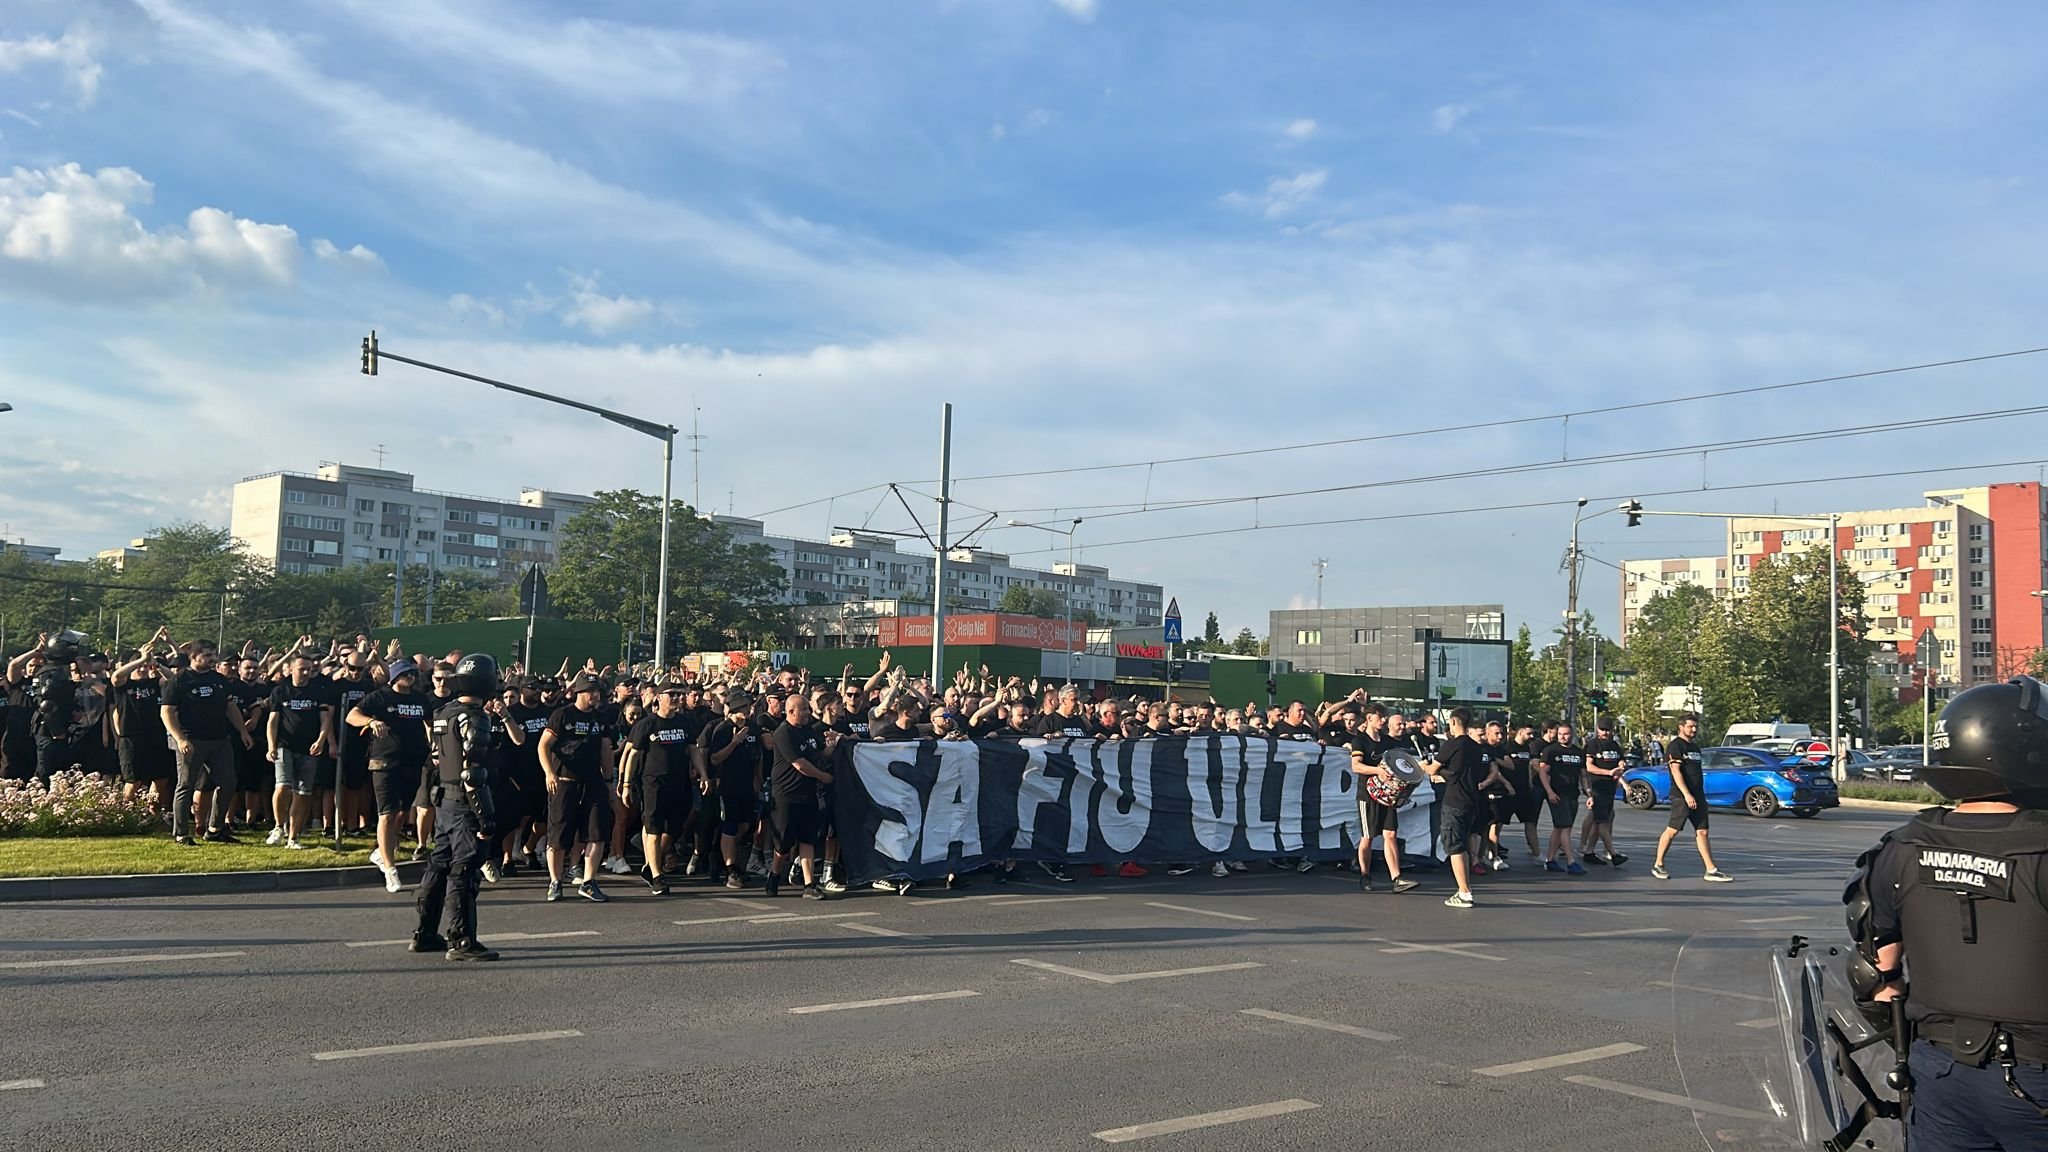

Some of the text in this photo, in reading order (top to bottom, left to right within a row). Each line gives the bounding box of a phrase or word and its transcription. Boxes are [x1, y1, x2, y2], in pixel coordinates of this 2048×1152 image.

[881, 620, 895, 631] NON
[904, 621, 987, 638] Farmacii Help Net
[880, 632, 896, 643] STOP
[776, 654, 787, 669] M
[1011, 737, 1158, 854] FIU
[1183, 735, 1448, 862] ULTRA
[1919, 851, 2007, 878] JANDARMERIA
